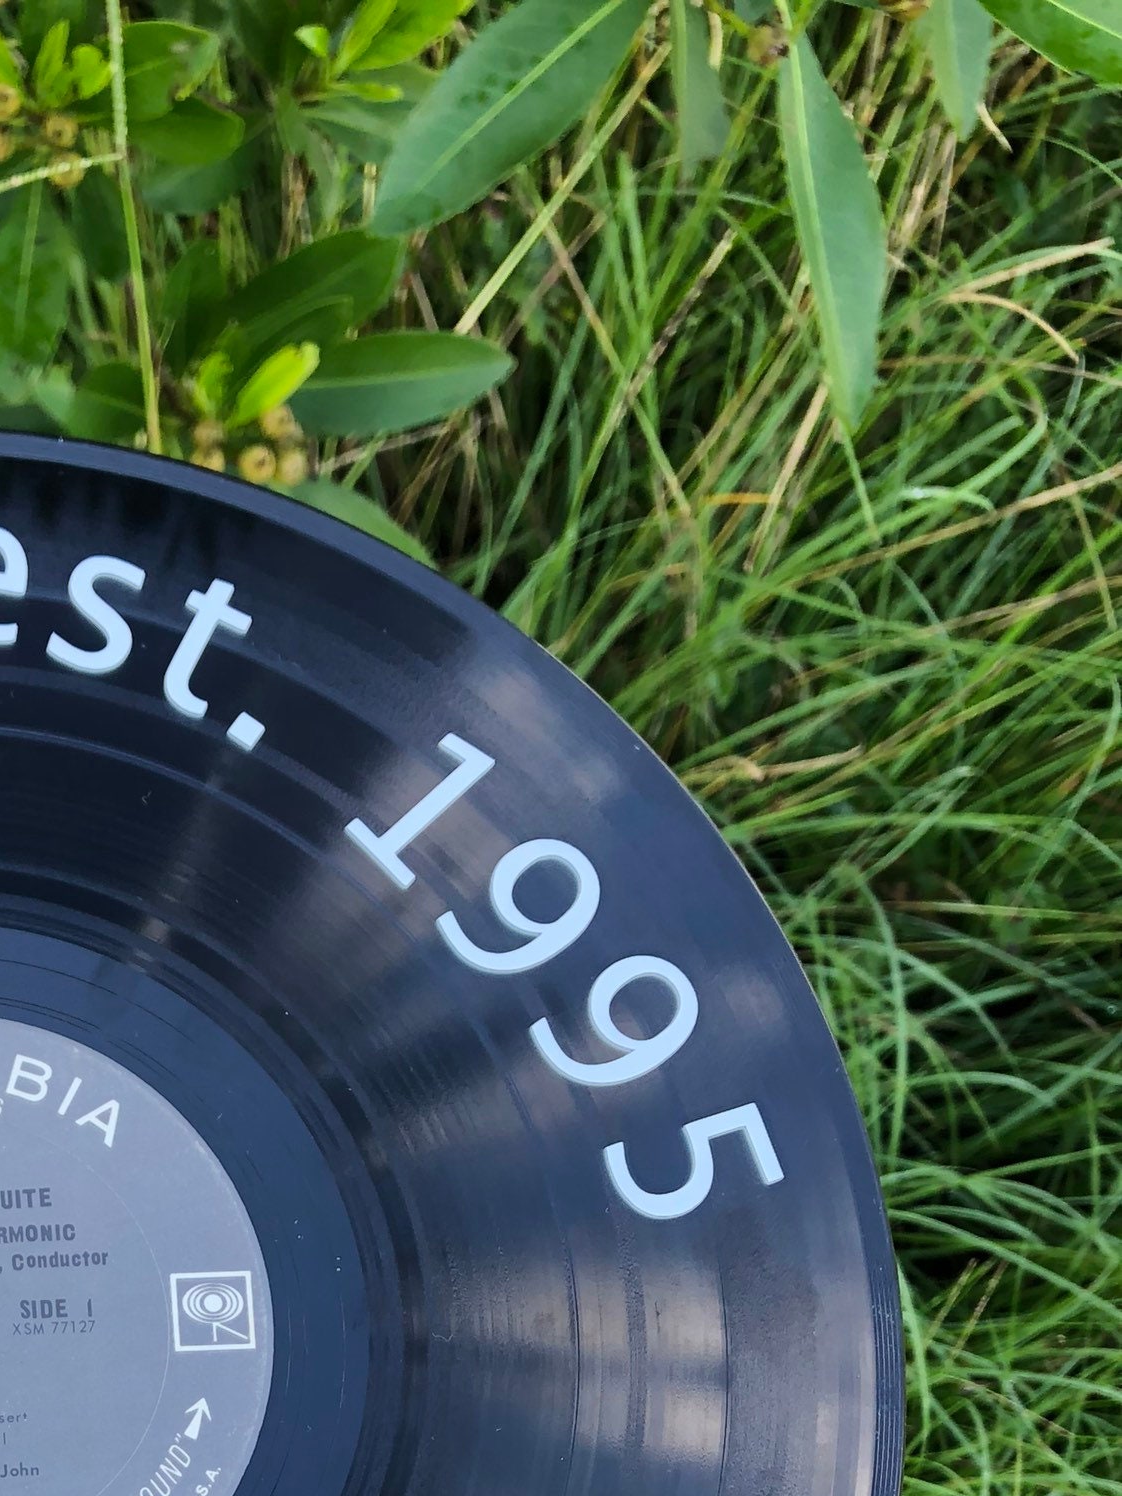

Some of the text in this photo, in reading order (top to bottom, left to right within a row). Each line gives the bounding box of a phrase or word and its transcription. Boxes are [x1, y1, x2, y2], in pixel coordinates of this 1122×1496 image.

[342, 731, 785, 1221] 1995
[11, 1250, 109, 1271] Conductor
[19, 1299, 68, 1319] SIDE
[12, 1320, 96, 1336] XSM 77127
[0, 1461, 40, 1478] John
